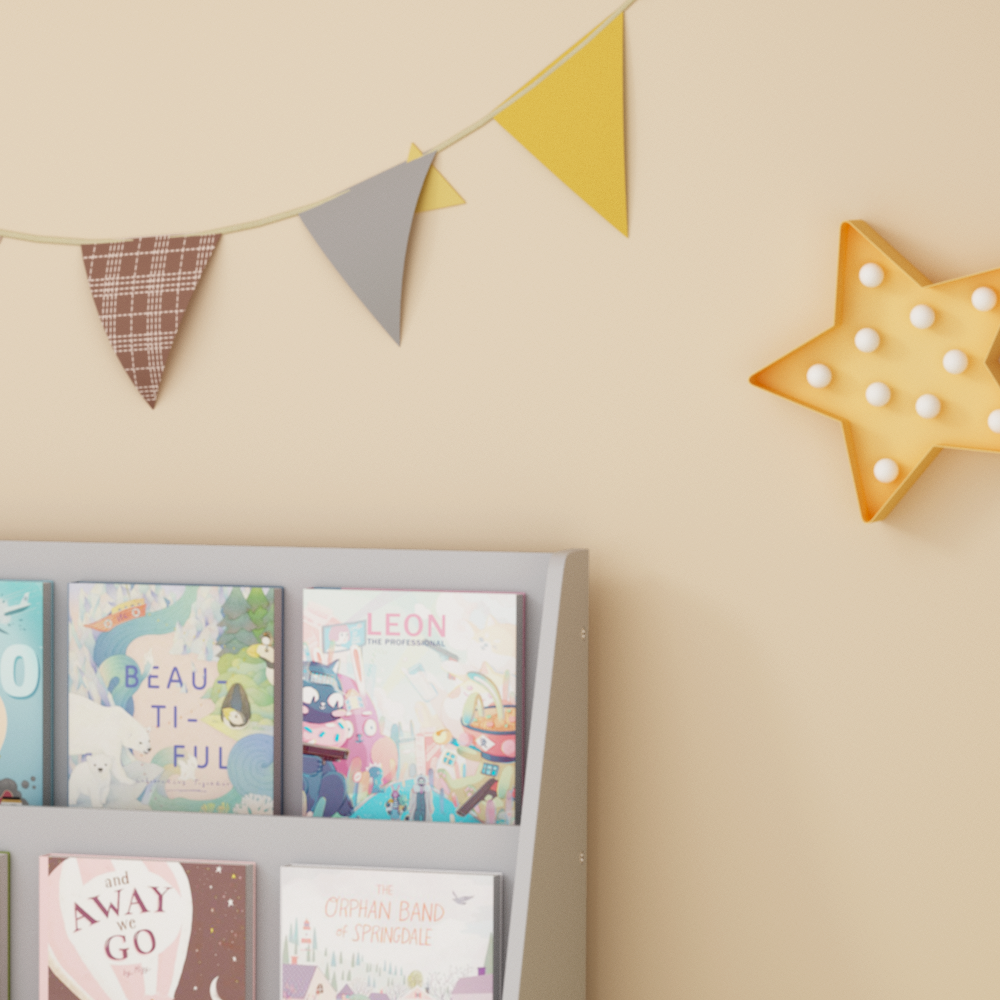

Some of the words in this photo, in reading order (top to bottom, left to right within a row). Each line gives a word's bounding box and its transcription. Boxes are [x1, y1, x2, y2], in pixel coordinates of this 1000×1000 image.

[367, 612, 446, 638] LEON
[367, 638, 382, 646] THE
[385, 638, 446, 648] PROFESSIONAL
[173, 745, 228, 769] FUL
[105, 870, 130, 888] and
[376, 884, 393, 895] THE
[73, 885, 173, 933] AWAY
[324, 896, 392, 920] ORPHAN
[398, 900, 446, 922] BAND
[116, 919, 137, 931] we
[335, 924, 349, 938] of
[352, 923, 433, 947] SPRINGDALE
[104, 928, 156, 961] GO
